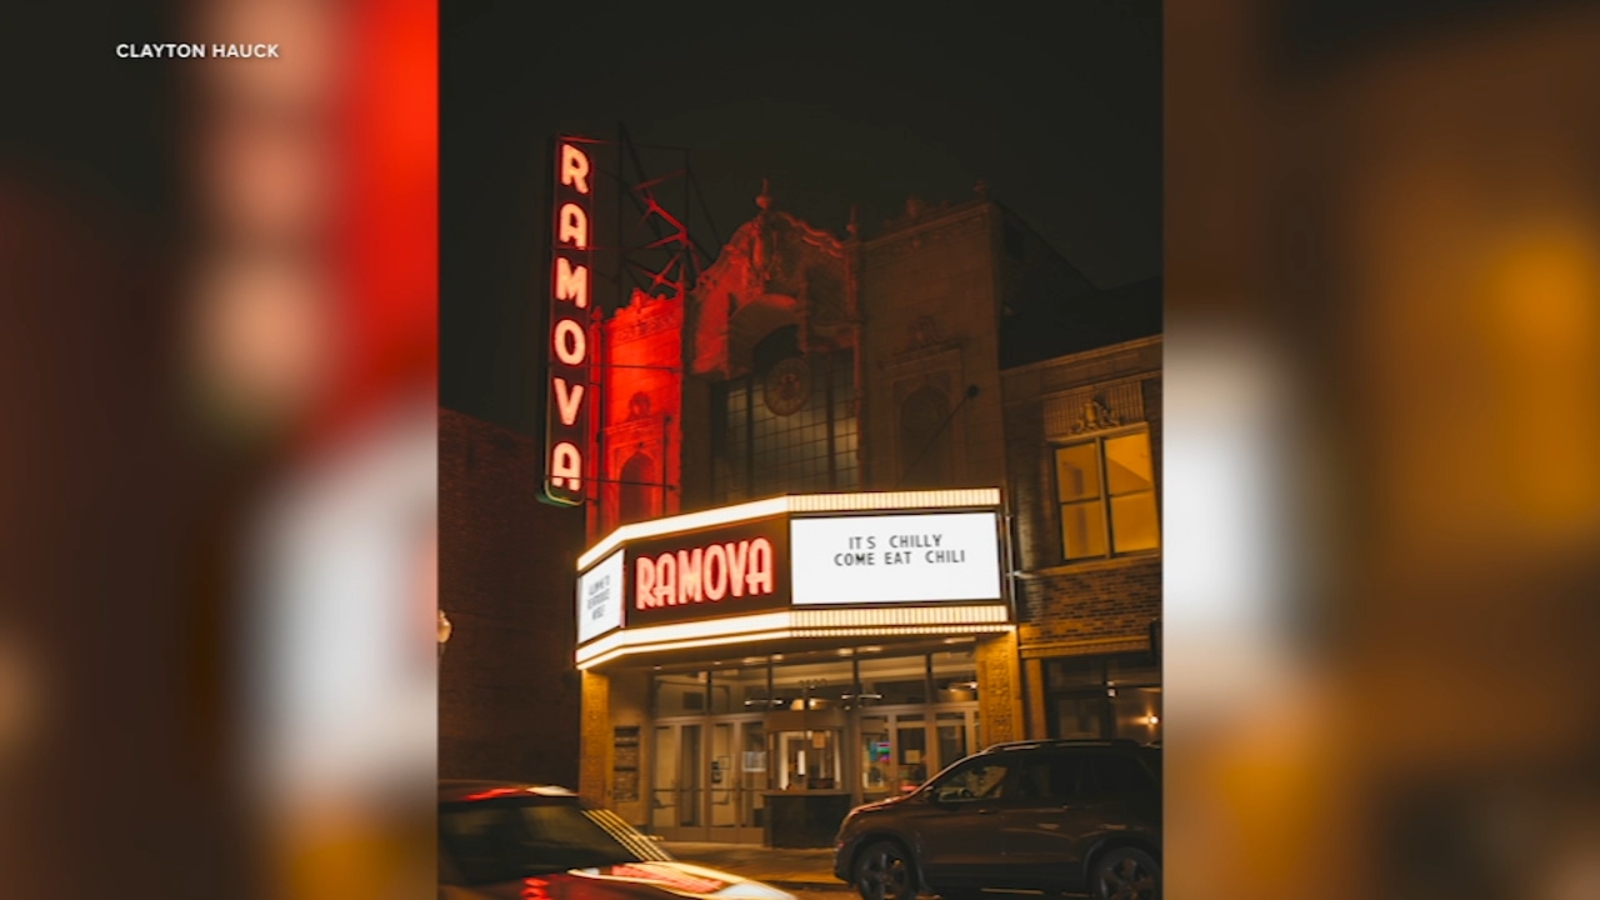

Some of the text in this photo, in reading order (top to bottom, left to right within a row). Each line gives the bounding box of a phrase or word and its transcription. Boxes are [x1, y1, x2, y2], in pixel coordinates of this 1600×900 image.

[552, 144, 590, 491] RAMOVA
[834, 549, 965, 566] COME EAT CHILI
[889, 534, 942, 548] CHILLY
[635, 537, 773, 610] RAMOVA
